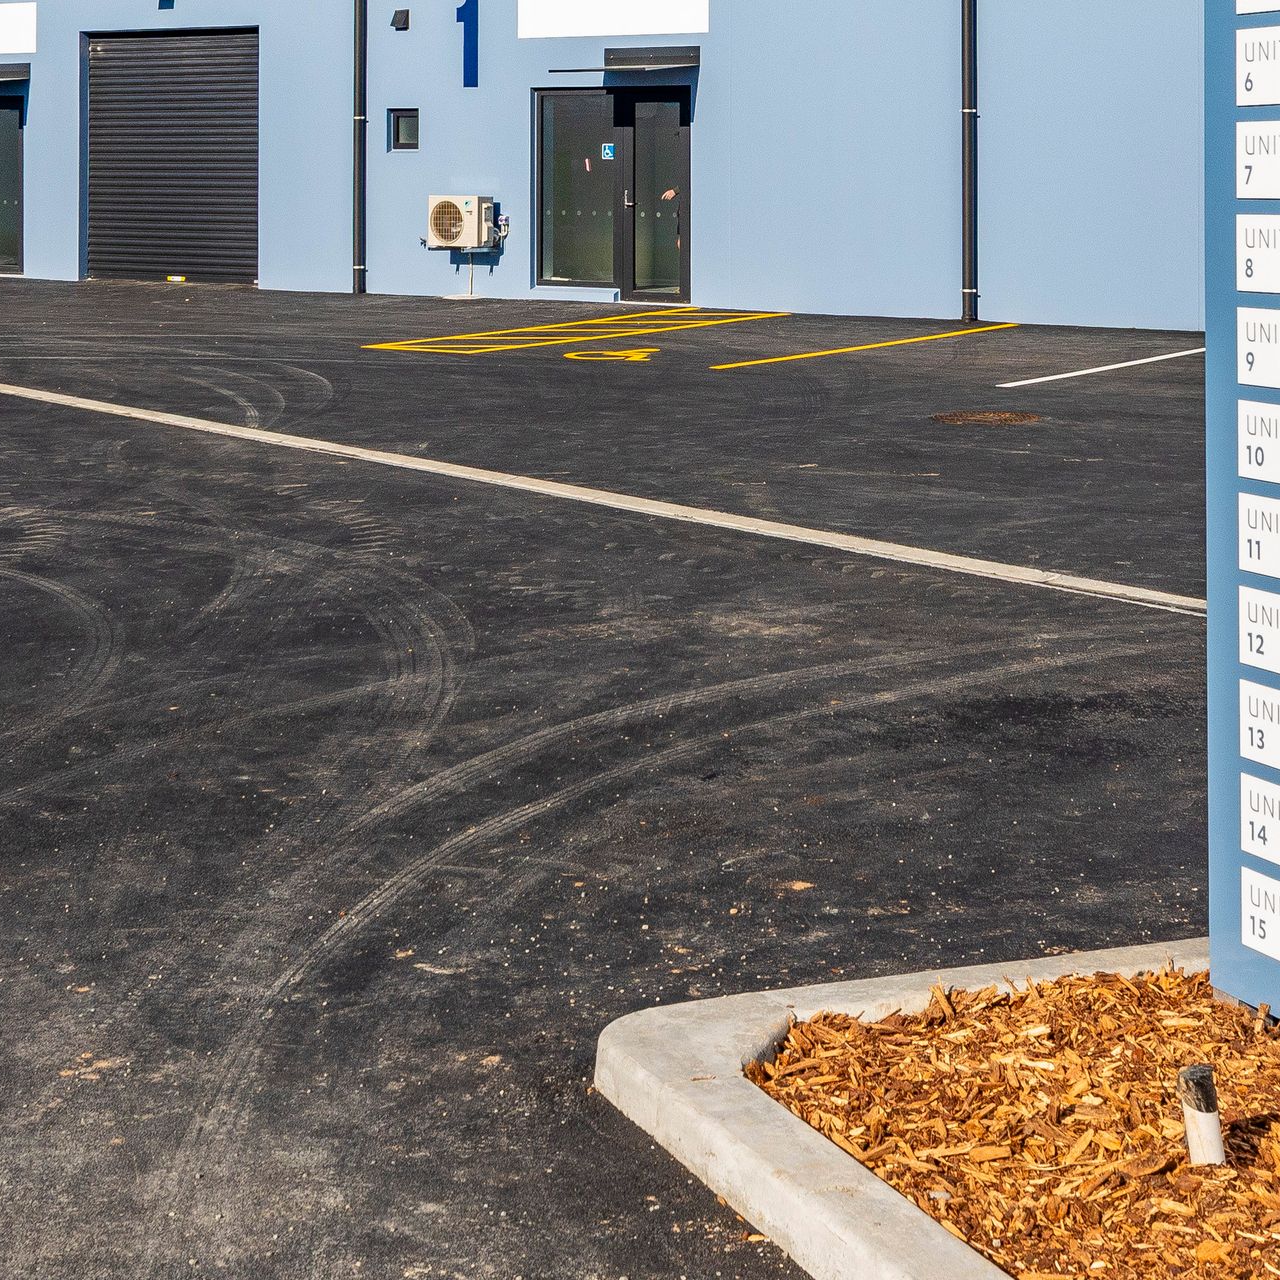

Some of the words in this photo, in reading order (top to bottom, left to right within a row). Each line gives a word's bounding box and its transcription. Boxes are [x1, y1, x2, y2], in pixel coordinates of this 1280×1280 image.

[1244, 71, 1254, 93] 6
[1243, 164, 1253, 186] 7
[1244, 257, 1254, 279] 8
[1245, 351, 1256, 373] 9
[1245, 444, 1265, 467] 10
[1246, 538, 1261, 561] 11
[1247, 631, 1265, 656] 12
[1247, 725, 1265, 750] 13
[1248, 820, 1269, 847] 14
[1249, 914, 1267, 940] 15
